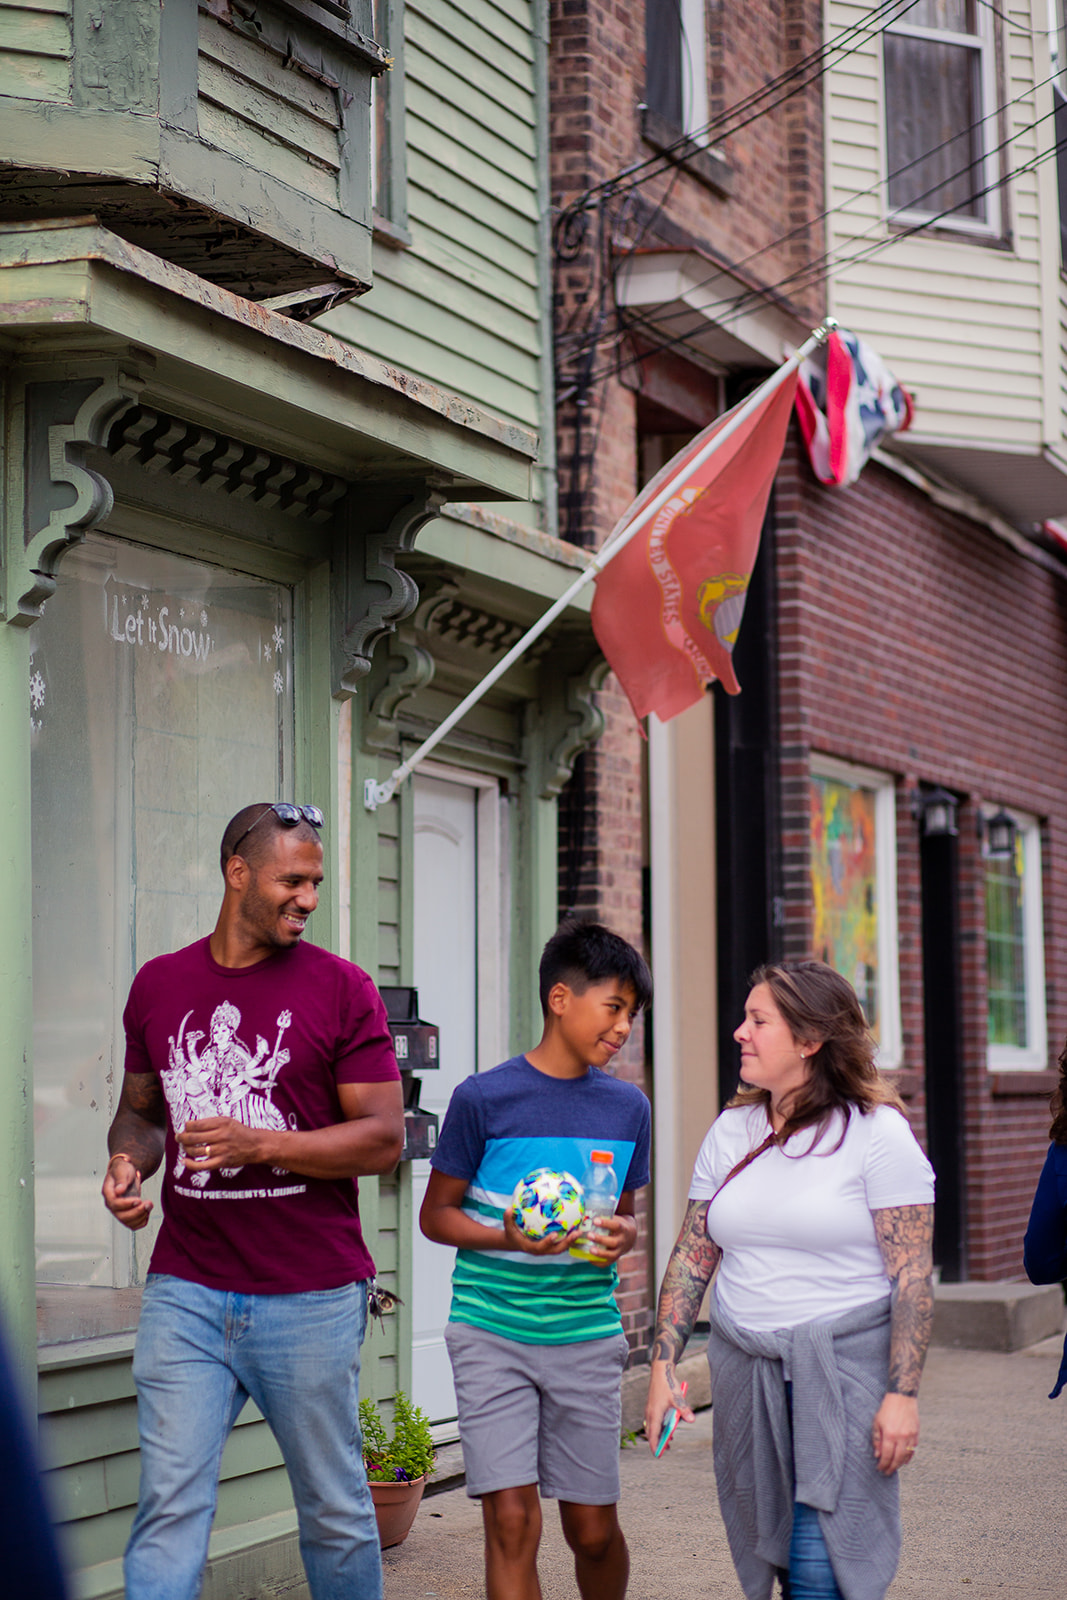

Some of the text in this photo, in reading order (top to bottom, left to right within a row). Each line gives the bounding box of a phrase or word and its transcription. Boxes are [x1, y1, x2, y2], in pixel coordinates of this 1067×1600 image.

[659, 570, 681, 625] STATES
[111, 594, 210, 661] Let It Snow
[203, 1189, 266, 1199] PRESIDENTS
[267, 1184, 306, 1197] LOUNGE
